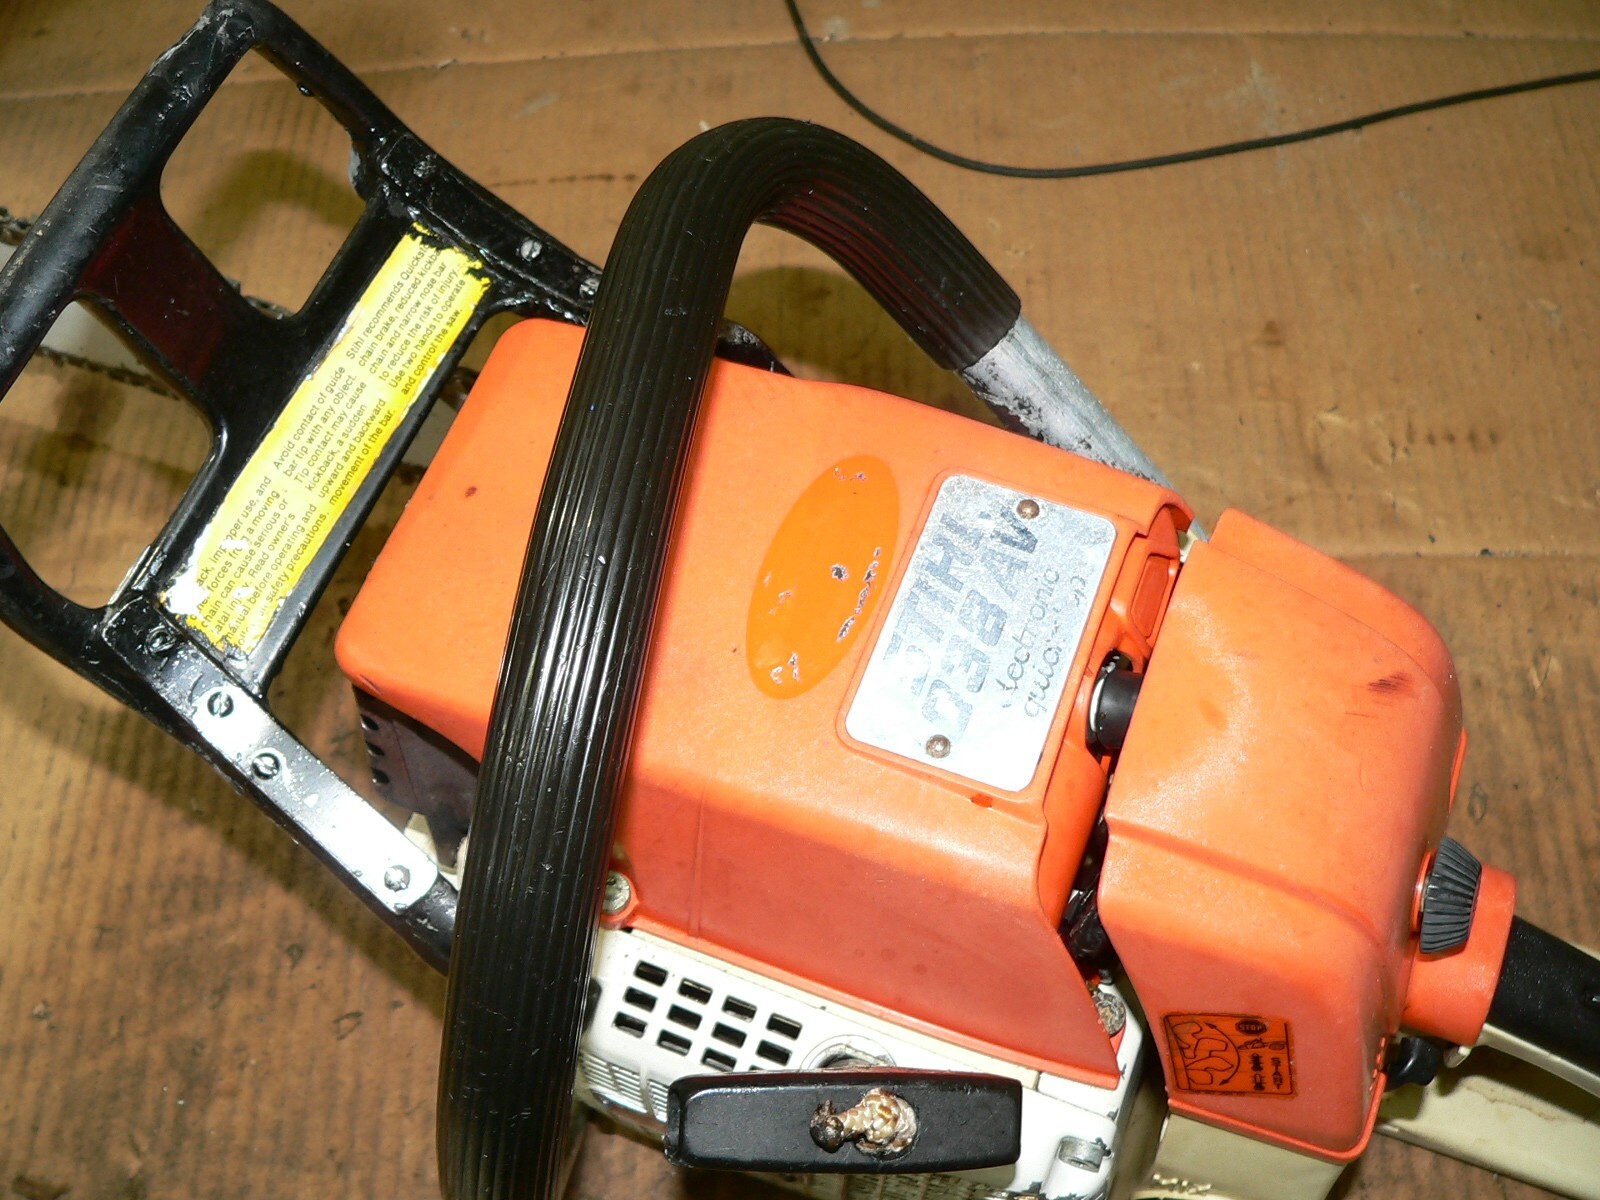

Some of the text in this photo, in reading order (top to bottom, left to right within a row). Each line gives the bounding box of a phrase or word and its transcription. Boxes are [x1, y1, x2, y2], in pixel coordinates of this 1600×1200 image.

[345, 241, 430, 360] Stihl recommends Quicksto
[355, 246, 442, 367] chain brake, reduced kickba
[366, 260, 447, 374] chain and narrow nose bar
[377, 368, 390, 382] to
[384, 337, 411, 370] reduce
[406, 320, 422, 338] the
[416, 303, 433, 323] risk
[428, 292, 440, 305] of
[388, 277, 468, 388] Use two hands to operate
[399, 306, 462, 395] and control the saw.
[271, 364, 348, 470] Avoid contact of guide
[282, 371, 359, 477] bar tip with any object.
[293, 380, 367, 485] Tip contact may cause
[304, 402, 367, 493] kickback, a sudden
[315, 397, 386, 500] upward and backward
[326, 406, 395, 506] movement of the bar.
[240, 496, 260, 519] use,
[253, 475, 271, 496] and
[245, 526, 254, 534] a
[249, 488, 280, 527] moving
[198, 598, 222, 628] chain
[219, 579, 236, 599] can
[232, 548, 256, 579] cause
[251, 510, 280, 548] serious
[277, 498, 289, 511] or
[206, 558, 232, 592] forces
[210, 610, 231, 635] atal
[247, 550, 269, 578] Read
[266, 512, 295, 551] owner's
[246, 570, 273, 604] before
[268, 523, 306, 572] operating
[299, 502, 317, 523] and
[263, 570, 291, 604] safety
[284, 508, 331, 572] precautions.
